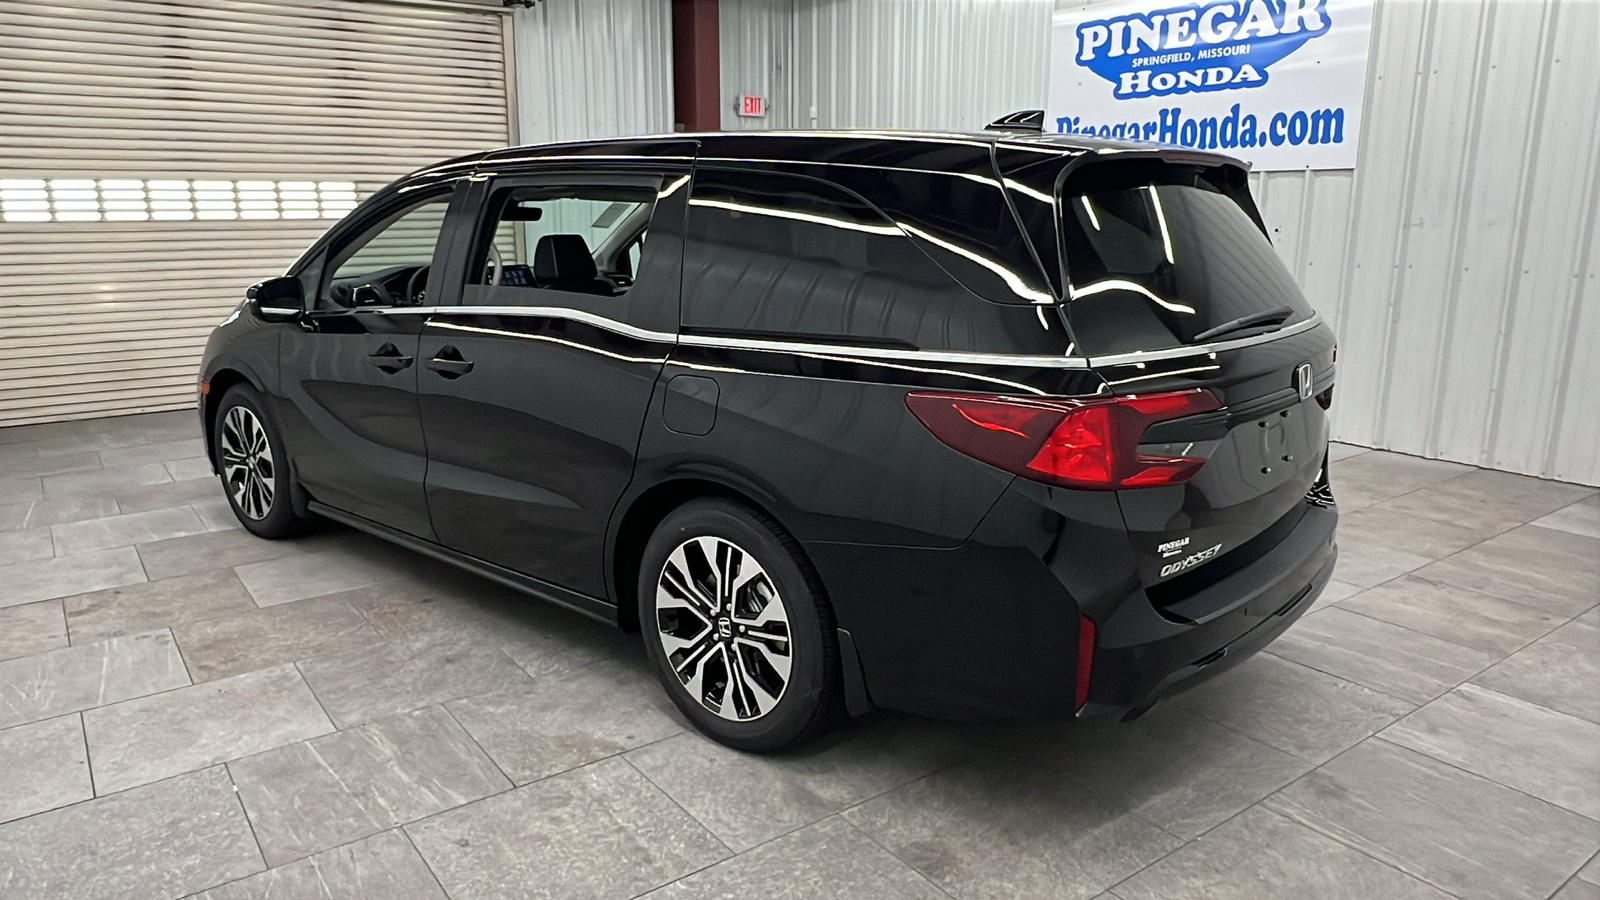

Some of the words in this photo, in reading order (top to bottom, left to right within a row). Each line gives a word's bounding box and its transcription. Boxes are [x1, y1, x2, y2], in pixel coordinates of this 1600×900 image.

[1079, 0, 1325, 61] PINEGAR
[1132, 52, 1195, 68] SPRINGFIELD,
[1197, 44, 1250, 60] MISSOURI
[744, 96, 762, 114] EXIT
[1160, 543, 1222, 577] ODYSSEY
